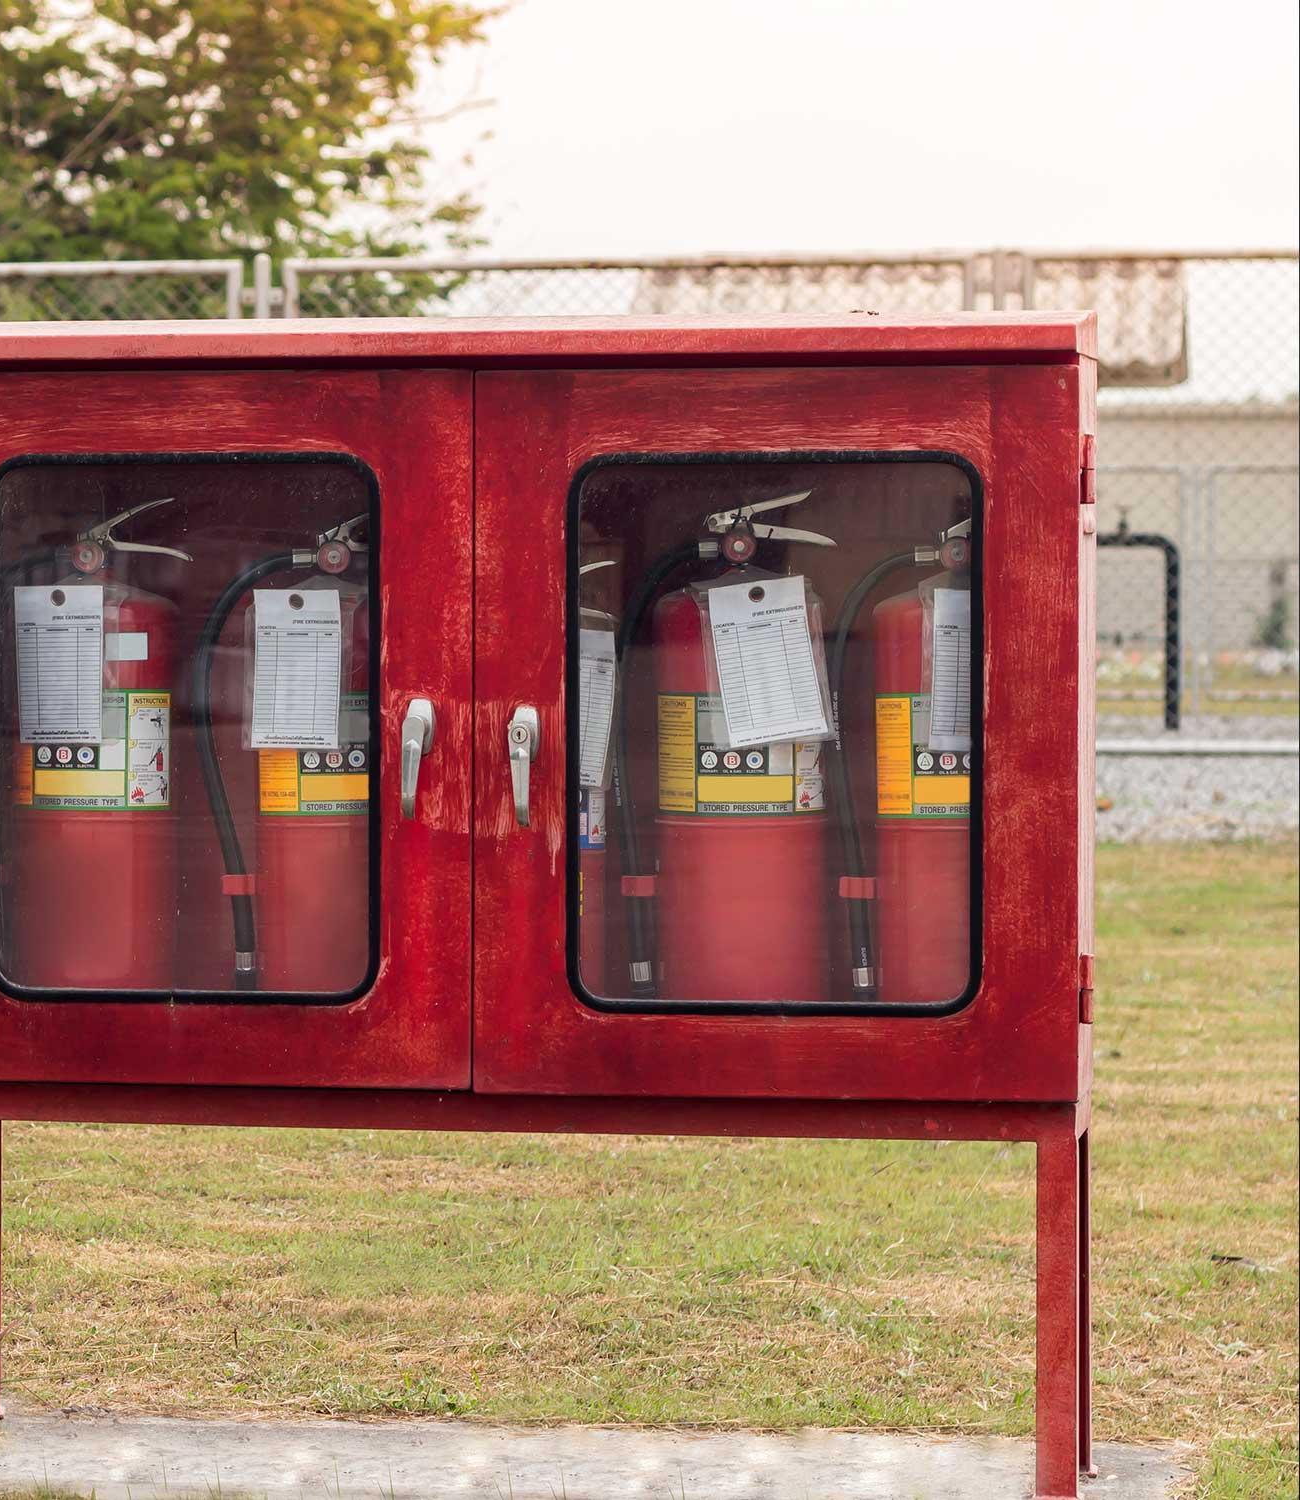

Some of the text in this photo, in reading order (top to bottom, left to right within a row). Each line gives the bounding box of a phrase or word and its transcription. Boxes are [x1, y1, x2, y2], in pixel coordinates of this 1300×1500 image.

[102, 798, 118, 806] TYPE
[703, 804, 730, 812] STORED
[732, 804, 769, 812] PRESSURE
[771, 803, 788, 811] TYPE
[920, 806, 946, 814] STORED
